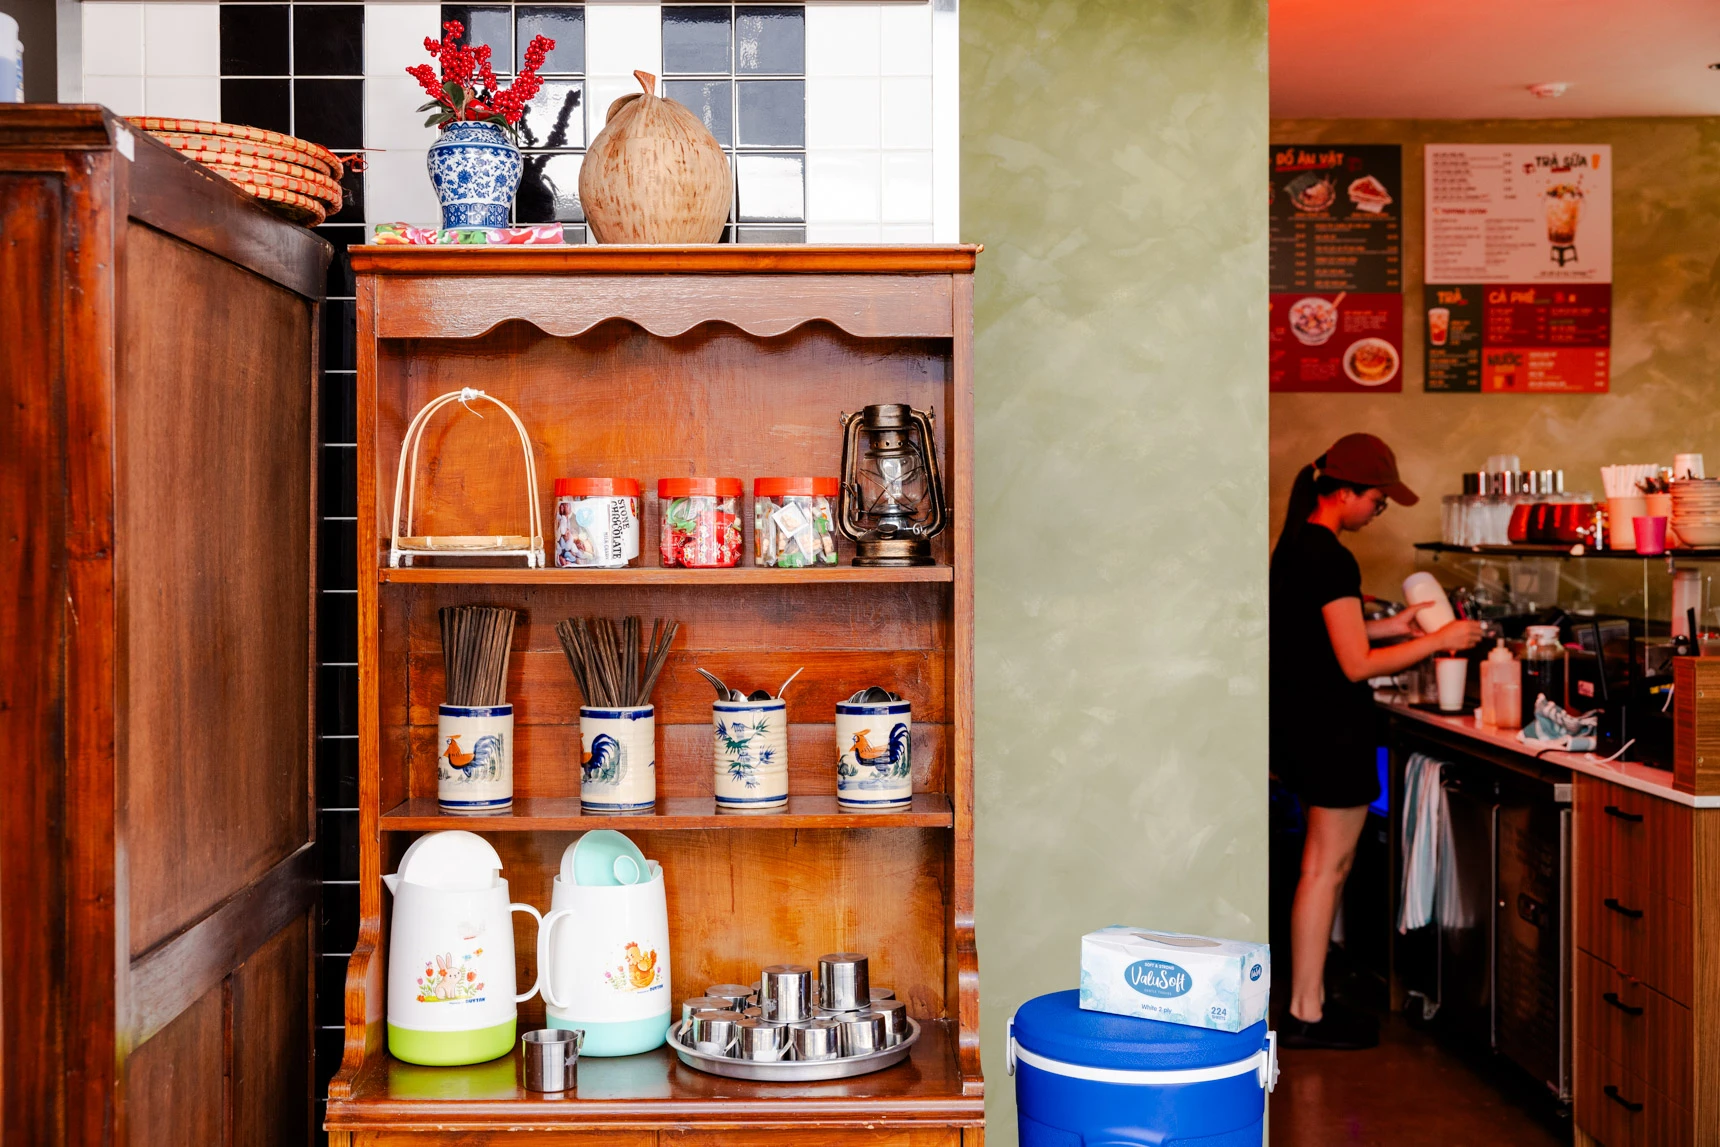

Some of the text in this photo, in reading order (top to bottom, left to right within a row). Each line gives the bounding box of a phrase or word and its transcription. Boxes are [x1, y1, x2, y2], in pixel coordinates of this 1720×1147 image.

[617, 498, 630, 530] STONE
[1131, 965, 1186, 993] ValuSoft
[1141, 1003, 1157, 1012] White
[1163, 1007, 1173, 1015] ply
[1211, 1006, 1227, 1016] 224
